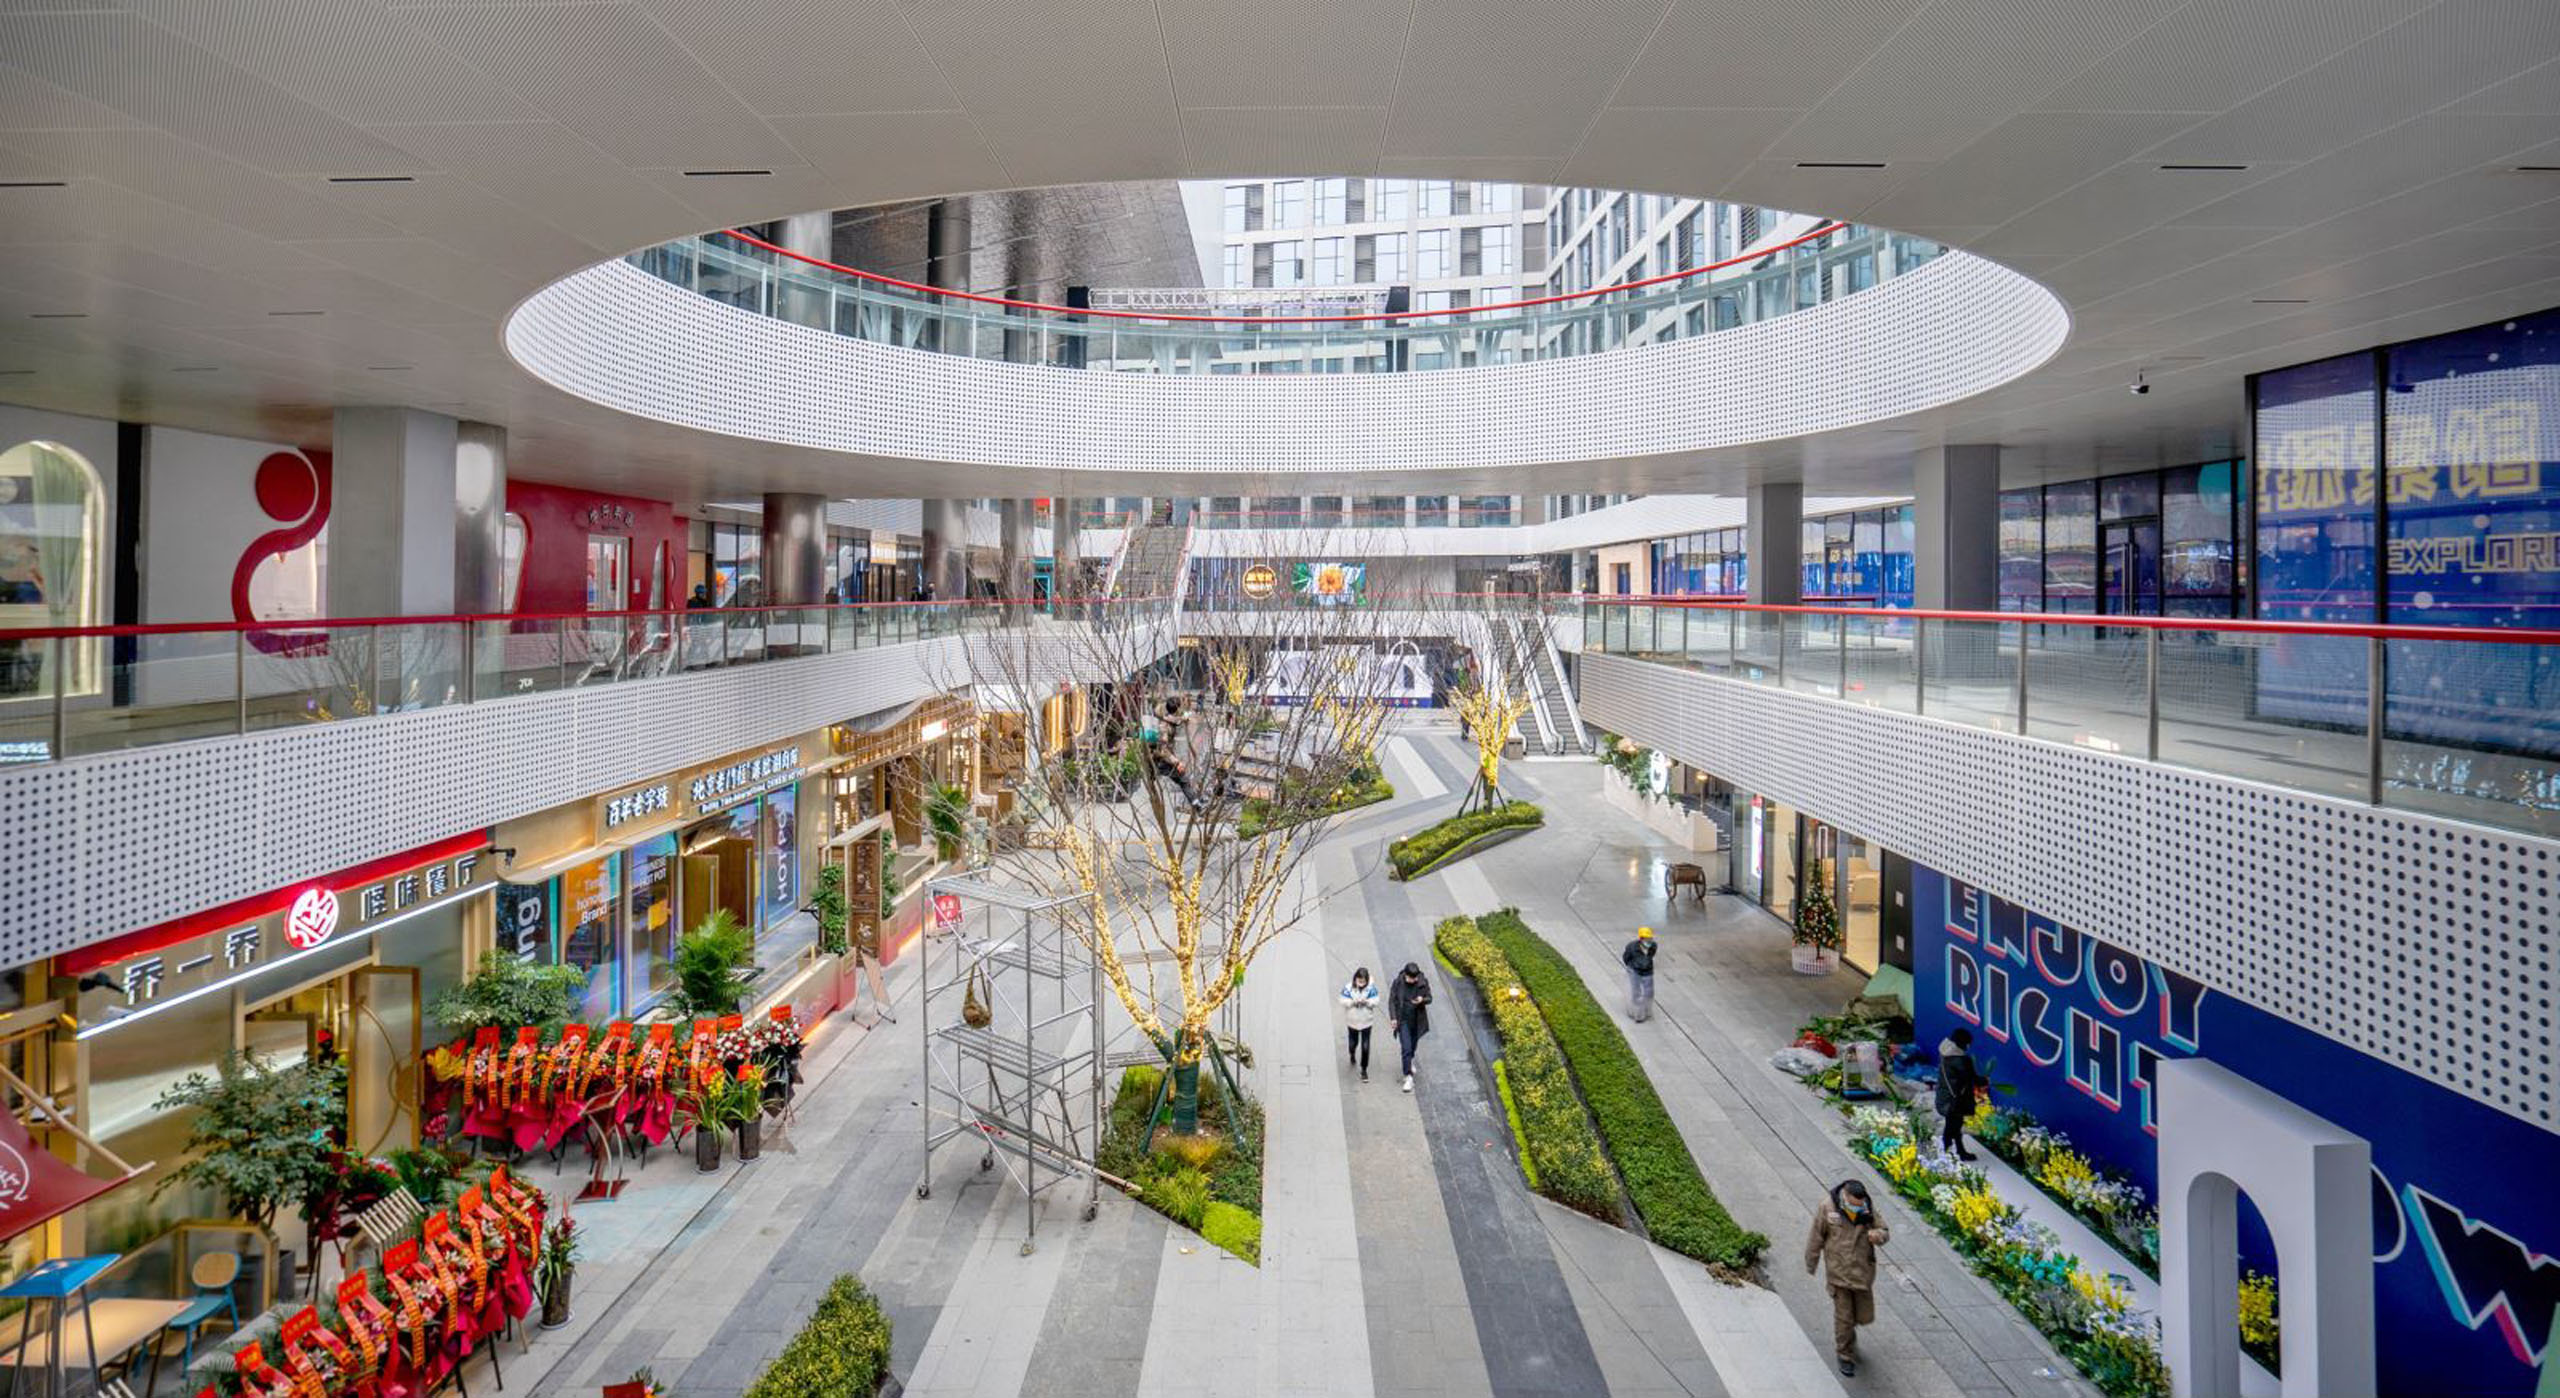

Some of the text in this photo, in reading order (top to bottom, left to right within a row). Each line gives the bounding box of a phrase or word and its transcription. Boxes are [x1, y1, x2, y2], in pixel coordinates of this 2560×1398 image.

[2256, 401, 2541, 514] 探索馆
[2387, 532, 2560, 575] EXPLOR
[360, 855, 477, 922] 怪味餐厅
[1945, 876, 2208, 1055] ENJOY
